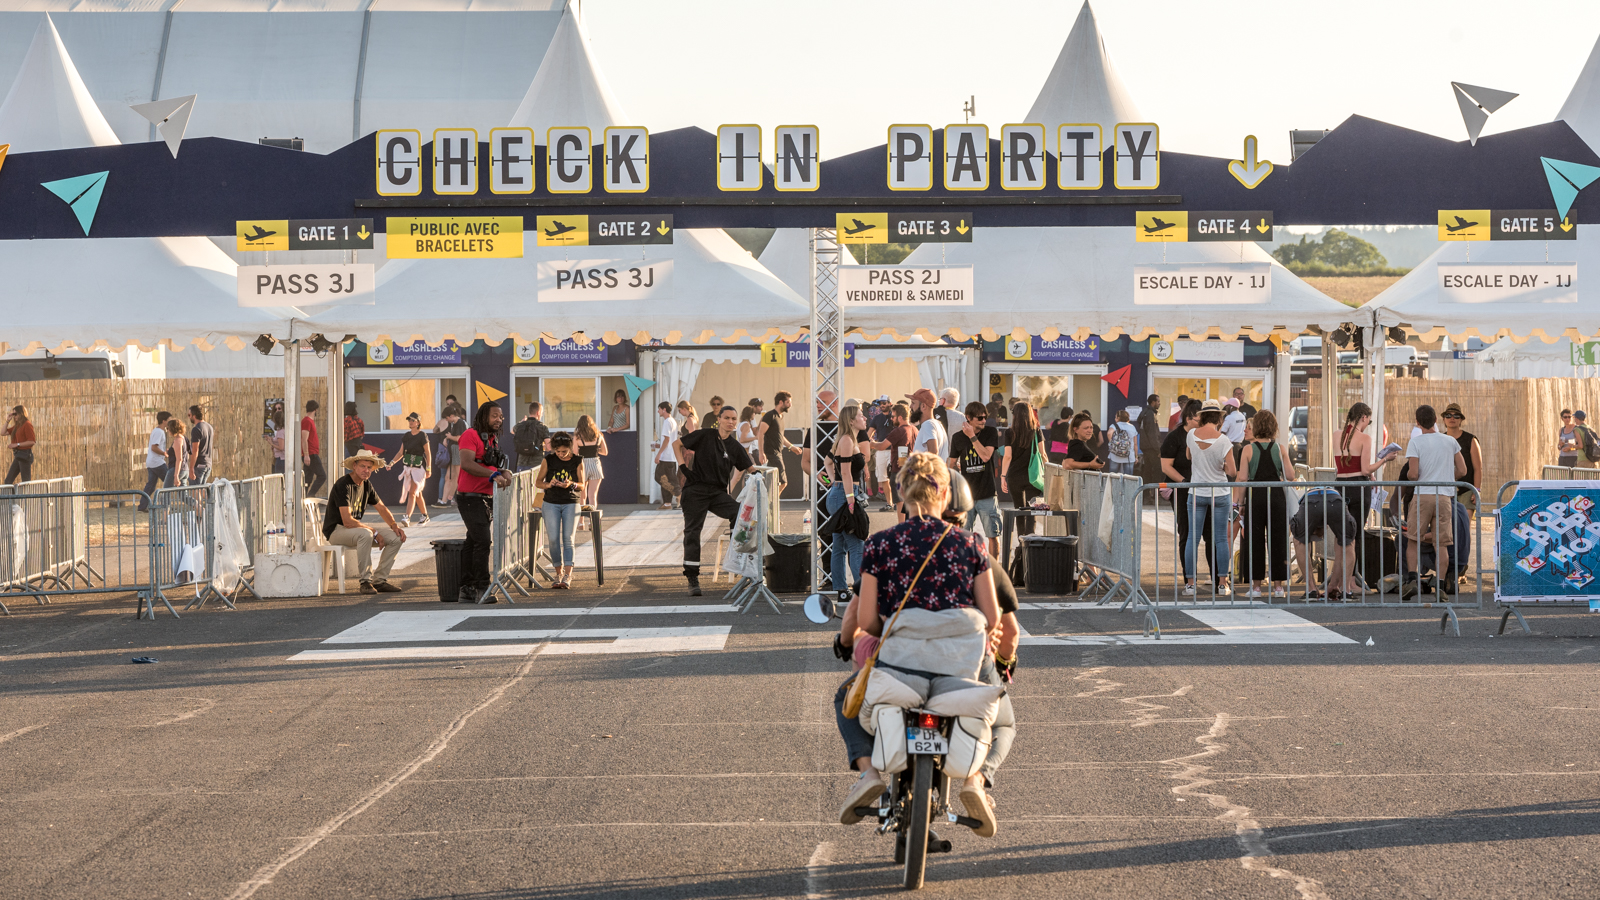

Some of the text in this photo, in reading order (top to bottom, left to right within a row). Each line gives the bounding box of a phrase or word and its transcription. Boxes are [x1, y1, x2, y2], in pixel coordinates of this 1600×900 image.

[385, 130, 1152, 186] CHECK IN PARTY
[410, 221, 500, 237] PUBLIC AVEC
[598, 220, 651, 237] GATE 2
[897, 219, 950, 236] GATE 3
[1197, 218, 1251, 234] GATE 4
[1500, 217, 1554, 233] GATE 5
[298, 225, 350, 242] GATE 1
[415, 239, 494, 253] BRACELETS
[256, 272, 355, 295] PASS 3J
[556, 267, 654, 290] PASS 3J
[868, 268, 941, 285] PASS 2J
[1139, 275, 1199, 290] ESCALE
[1204, 275, 1233, 289] DAY
[1249, 275, 1266, 289] 1J
[1443, 274, 1504, 289] ESCALE
[1508, 274, 1539, 288] DAY
[1555, 274, 1571, 288] 1J
[846, 289, 964, 302] VENDREDI & SAMEDI
[403, 343, 448, 353] CASHLESS
[549, 342, 594, 351] CASHLESS
[1041, 340, 1086, 349] CASHLESS
[789, 350, 811, 361] POIN
[1518, 503, 1539, 518] FESTIVAL
